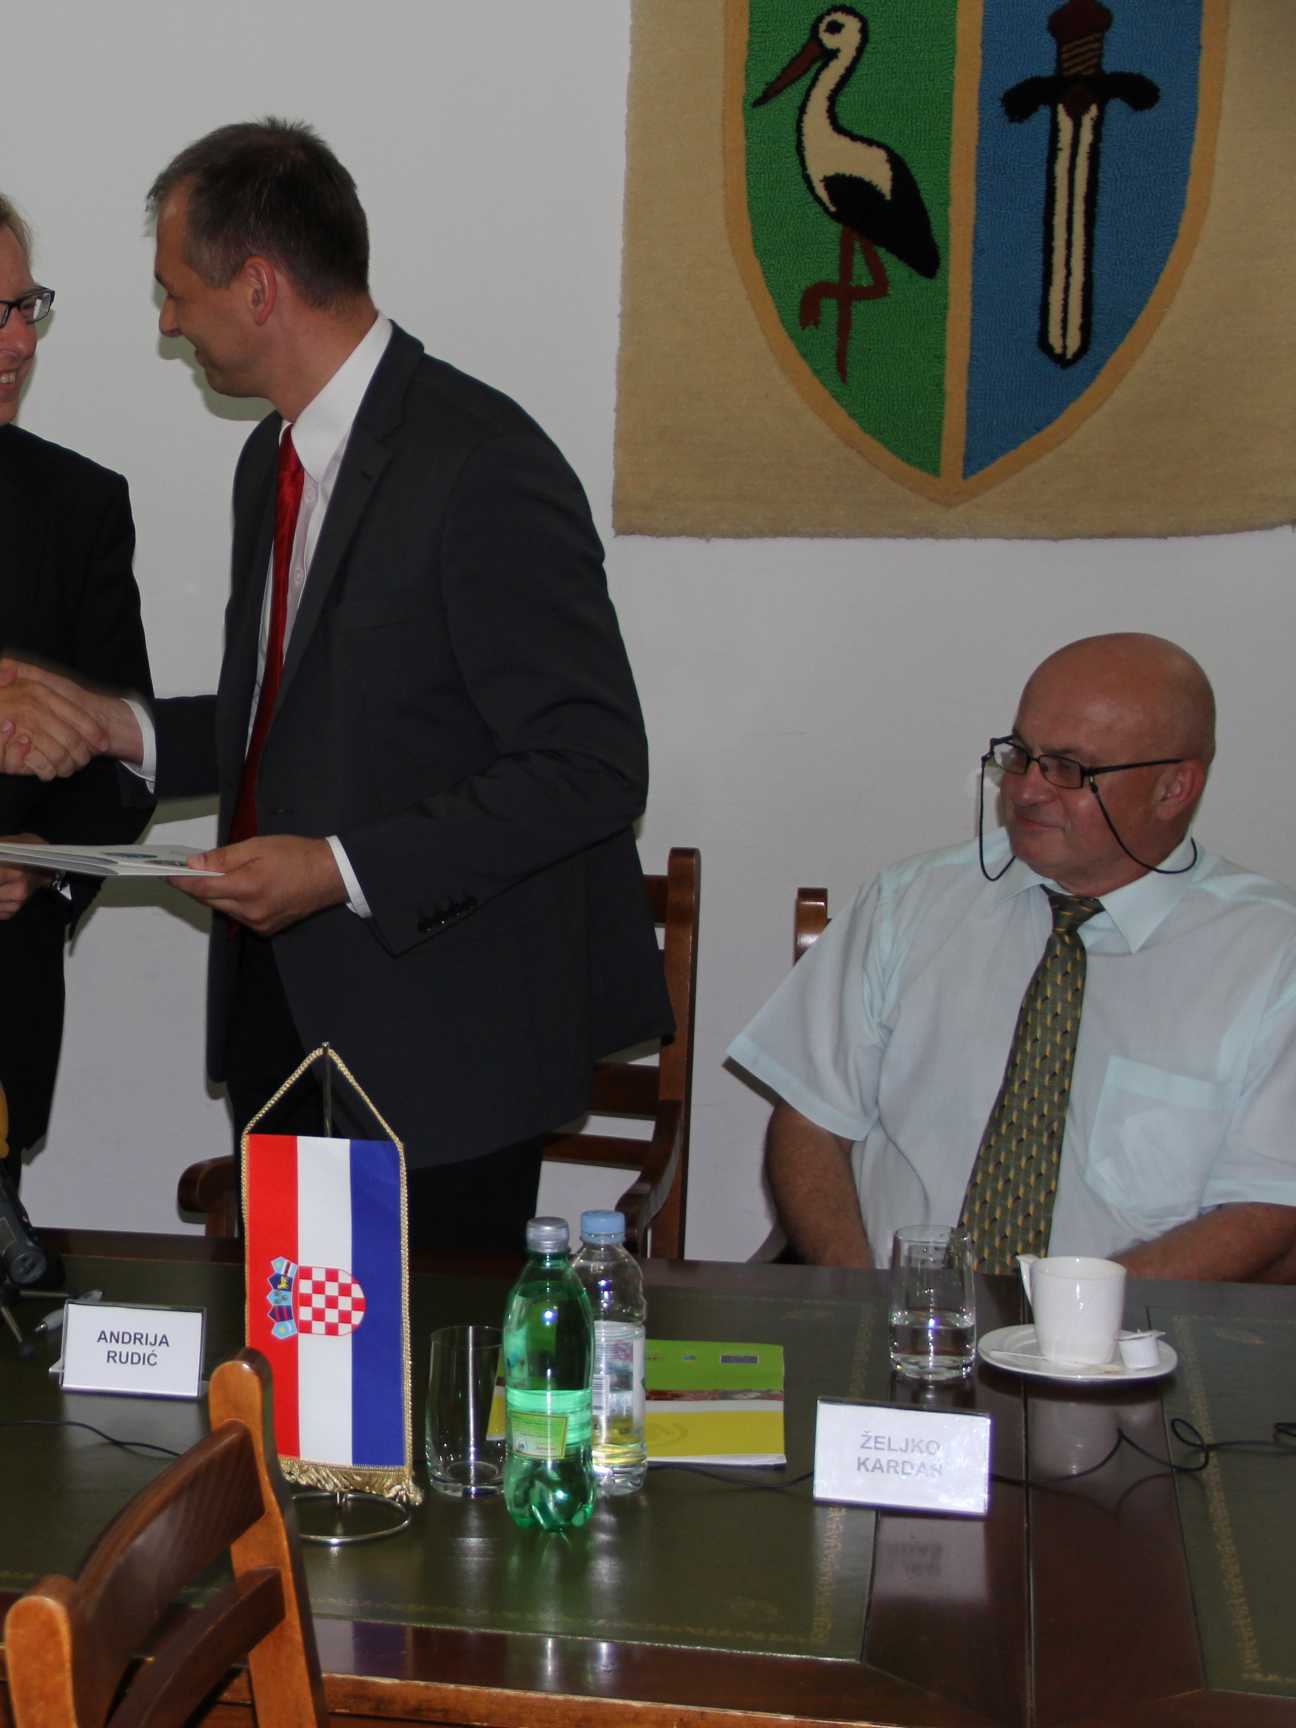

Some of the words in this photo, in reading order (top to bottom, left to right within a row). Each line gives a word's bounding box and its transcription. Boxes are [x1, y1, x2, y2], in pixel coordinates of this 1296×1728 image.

[96, 1330, 170, 1347] ANDRIJA
[106, 1349, 158, 1366] RUDIĆ
[860, 1430, 941, 1456] ŽELJKO
